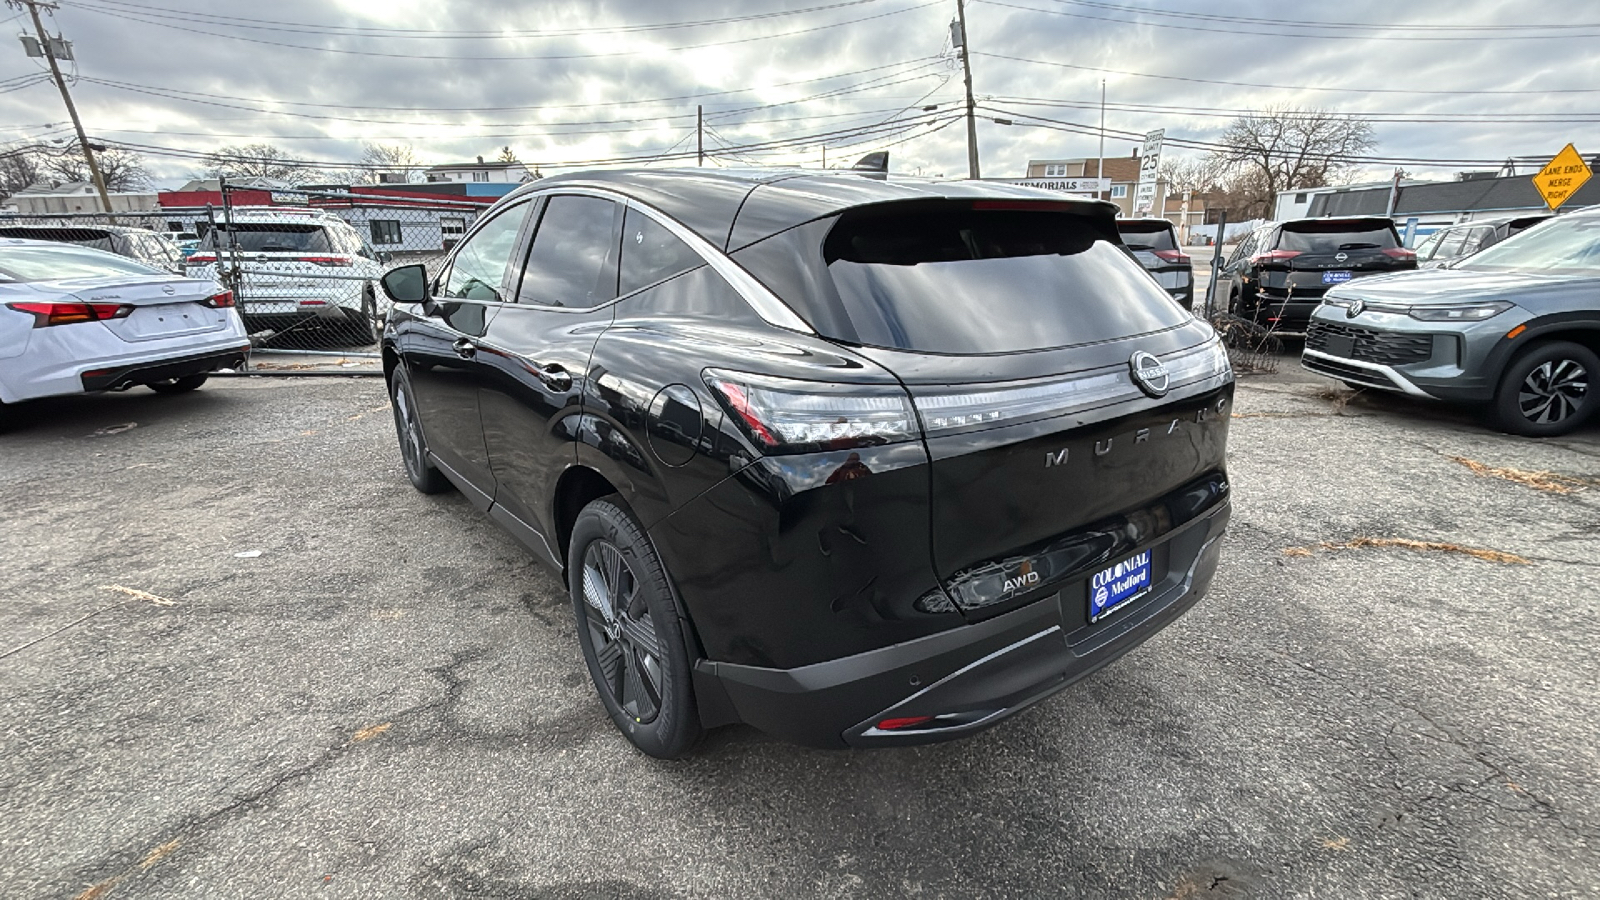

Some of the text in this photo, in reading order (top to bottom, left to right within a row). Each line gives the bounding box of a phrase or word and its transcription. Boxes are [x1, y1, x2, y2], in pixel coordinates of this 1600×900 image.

[1146, 133, 1163, 143] SPEED
[1145, 142, 1159, 152] LIMIT
[1141, 153, 1158, 171] 25
[1544, 165, 1583, 176] LANE ENDS
[1548, 178, 1572, 187] MERGE
[1547, 190, 1568, 199] RIGHT
[1045, 398, 1225, 468] MURANO
[1093, 553, 1149, 589] COLONIAL
[1003, 571, 1039, 592] AWD
[1111, 568, 1146, 597] Medford
